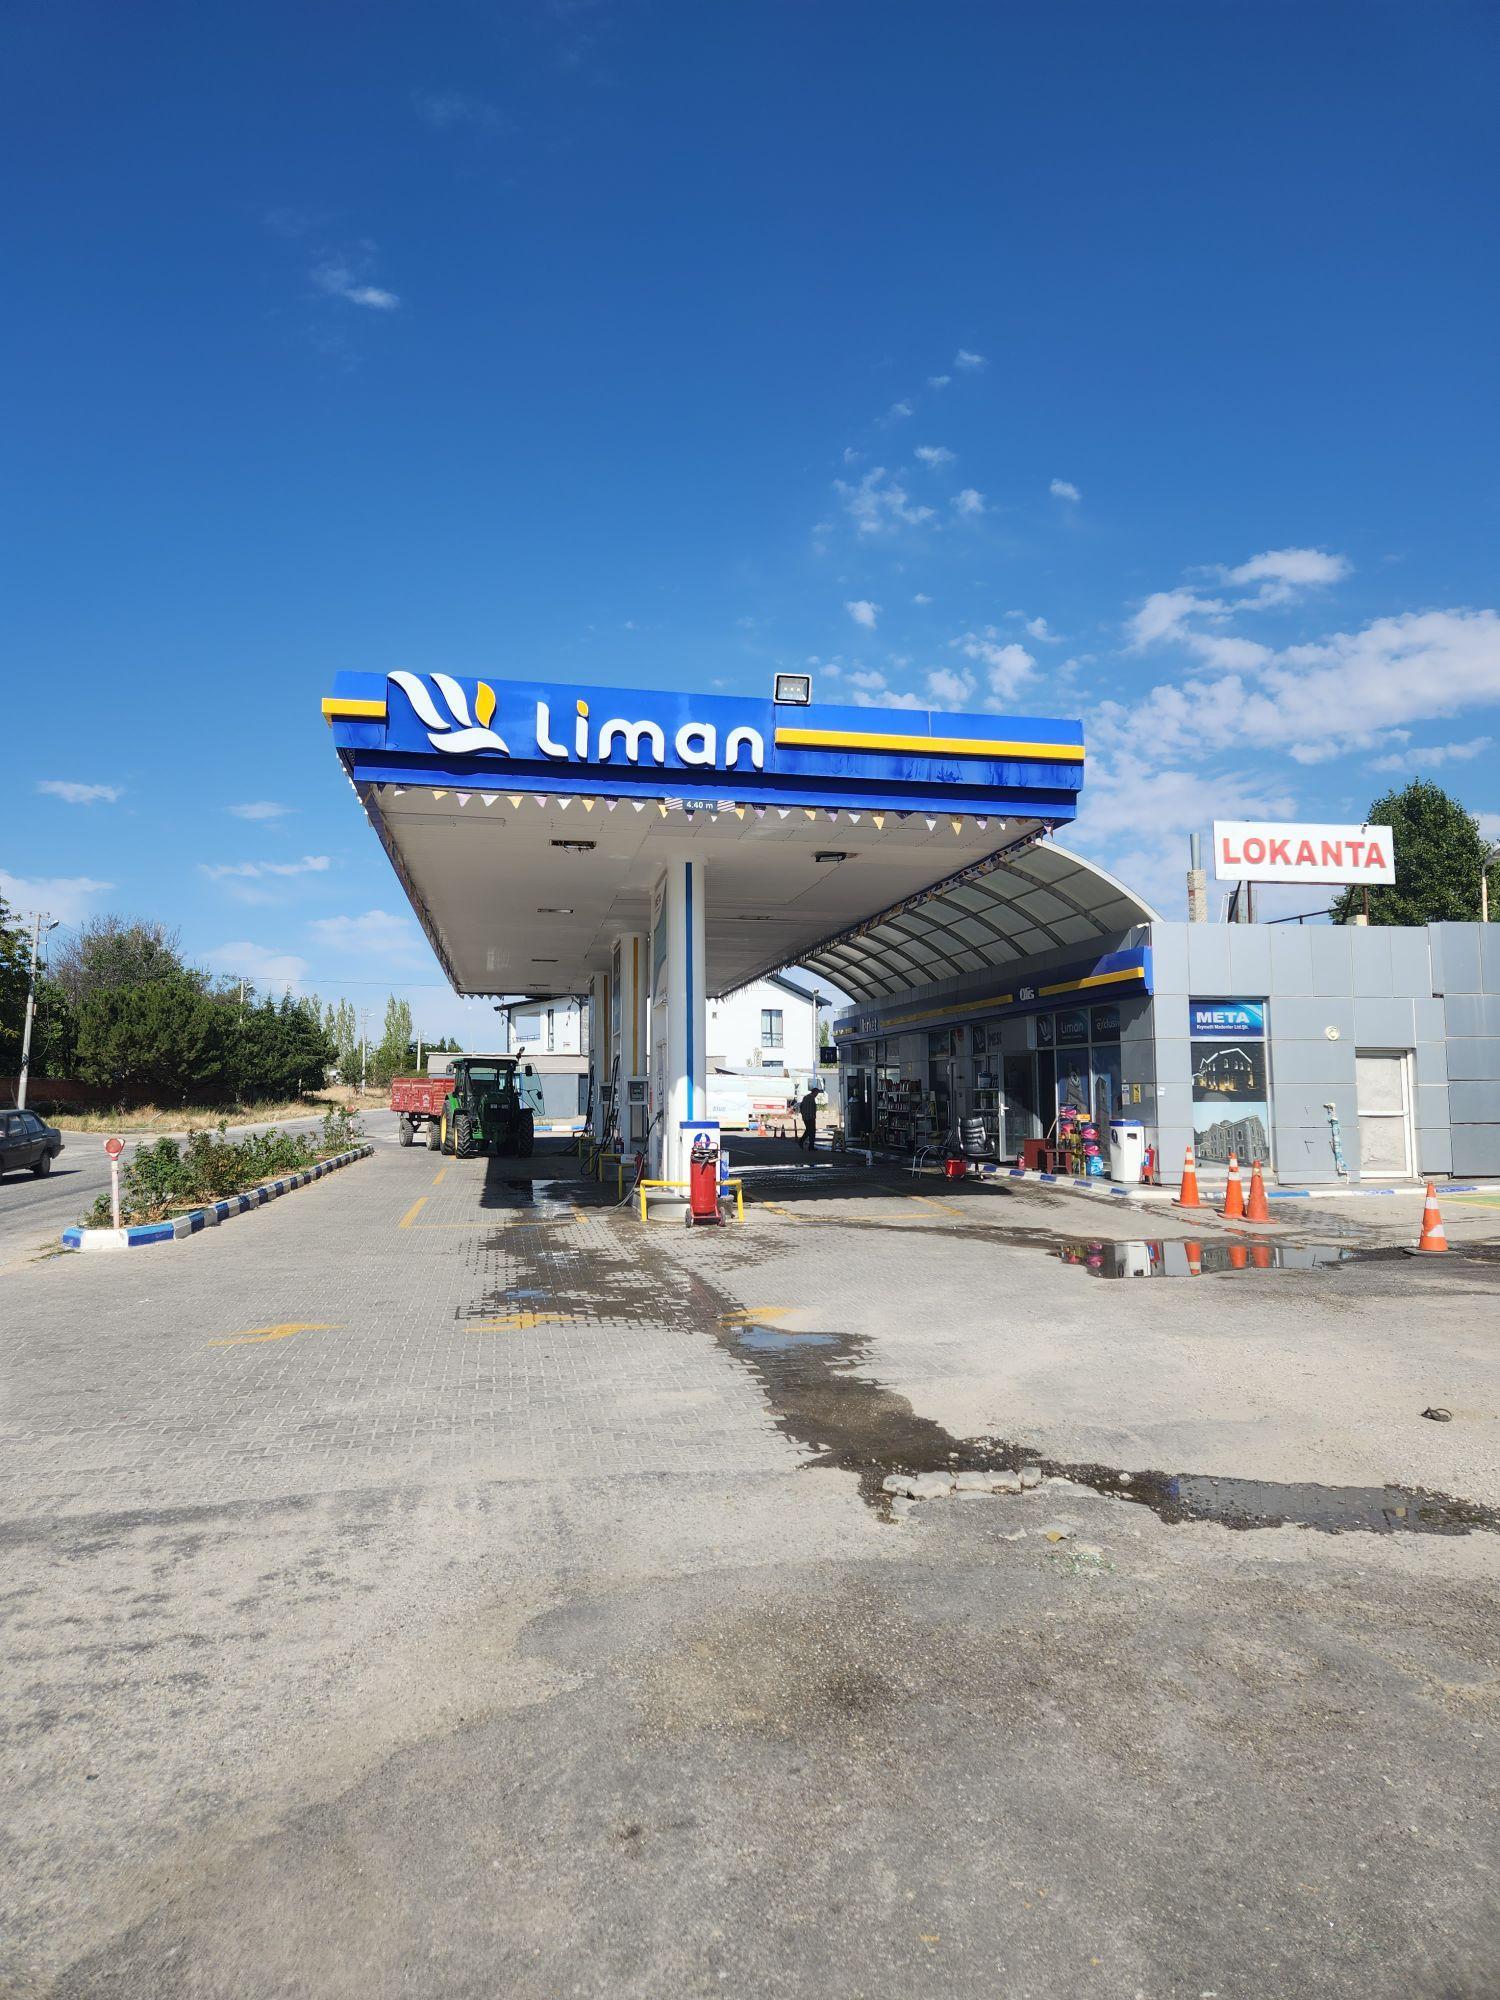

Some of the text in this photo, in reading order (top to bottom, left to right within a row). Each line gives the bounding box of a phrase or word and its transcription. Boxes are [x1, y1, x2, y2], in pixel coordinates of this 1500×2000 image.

[687, 801, 703, 809] 4.40
[1222, 837, 1387, 869] LOKANTA
[1196, 1011, 1250, 1024] META
